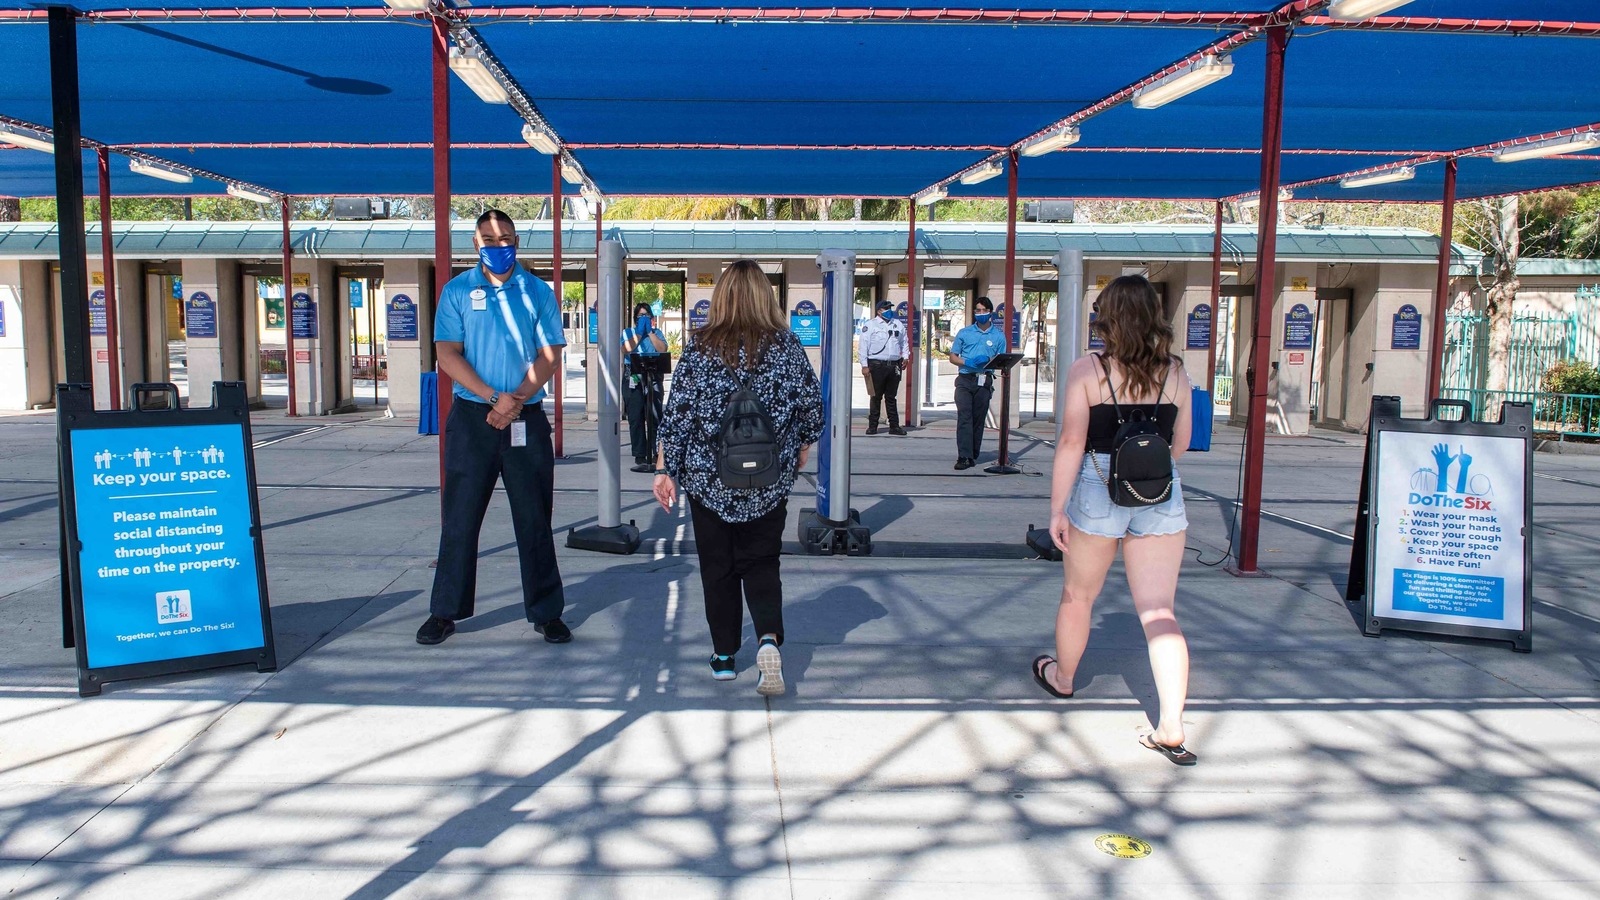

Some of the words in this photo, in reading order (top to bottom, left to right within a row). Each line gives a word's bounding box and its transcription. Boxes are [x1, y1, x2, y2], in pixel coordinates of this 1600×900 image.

[93, 473, 136, 487] Keep
[140, 472, 176, 486] your
[180, 469, 231, 483] space.
[1408, 492, 1492, 511] DoTheSix
[113, 511, 156, 523] Please
[159, 505, 217, 520] maintain
[1412, 510, 1440, 518] Wear
[1442, 513, 1466, 521] your
[1468, 514, 1497, 523] mask
[113, 527, 152, 541] social
[155, 523, 223, 538] distancing
[1411, 519, 1440, 527] Wash
[1442, 522, 1466, 530] your
[1468, 523, 1502, 533] hands
[1410, 528, 1440, 537] Cover
[1441, 531, 1465, 539] your
[1468, 534, 1502, 543] cough
[114, 542, 192, 558] throughout
[194, 541, 225, 555] your
[1400, 536, 1410, 544] 4.
[1412, 537, 1439, 547] Keep
[1441, 540, 1465, 548] your
[1468, 543, 1499, 551] space
[1407, 546, 1416, 554] 5.
[1419, 547, 1460, 558] Sanitize
[1463, 551, 1491, 560] often
[97, 566, 129, 578] time
[133, 565, 151, 575] on
[154, 561, 176, 573] the
[179, 556, 240, 574] property.
[1416, 556, 1426, 564] 6.
[1429, 557, 1455, 567] Have
[1458, 560, 1481, 569] Fun!
[1413, 579, 1447, 588] delivering
[1454, 582, 1474, 590] clean,
[1458, 578, 1495, 586] committed
[1436, 587, 1462, 595] thrilling
[1464, 589, 1476, 597] day
[1418, 596, 1451, 605] Together,
[161, 612, 189, 620] DoTheSix
[116, 631, 157, 642] Together,
